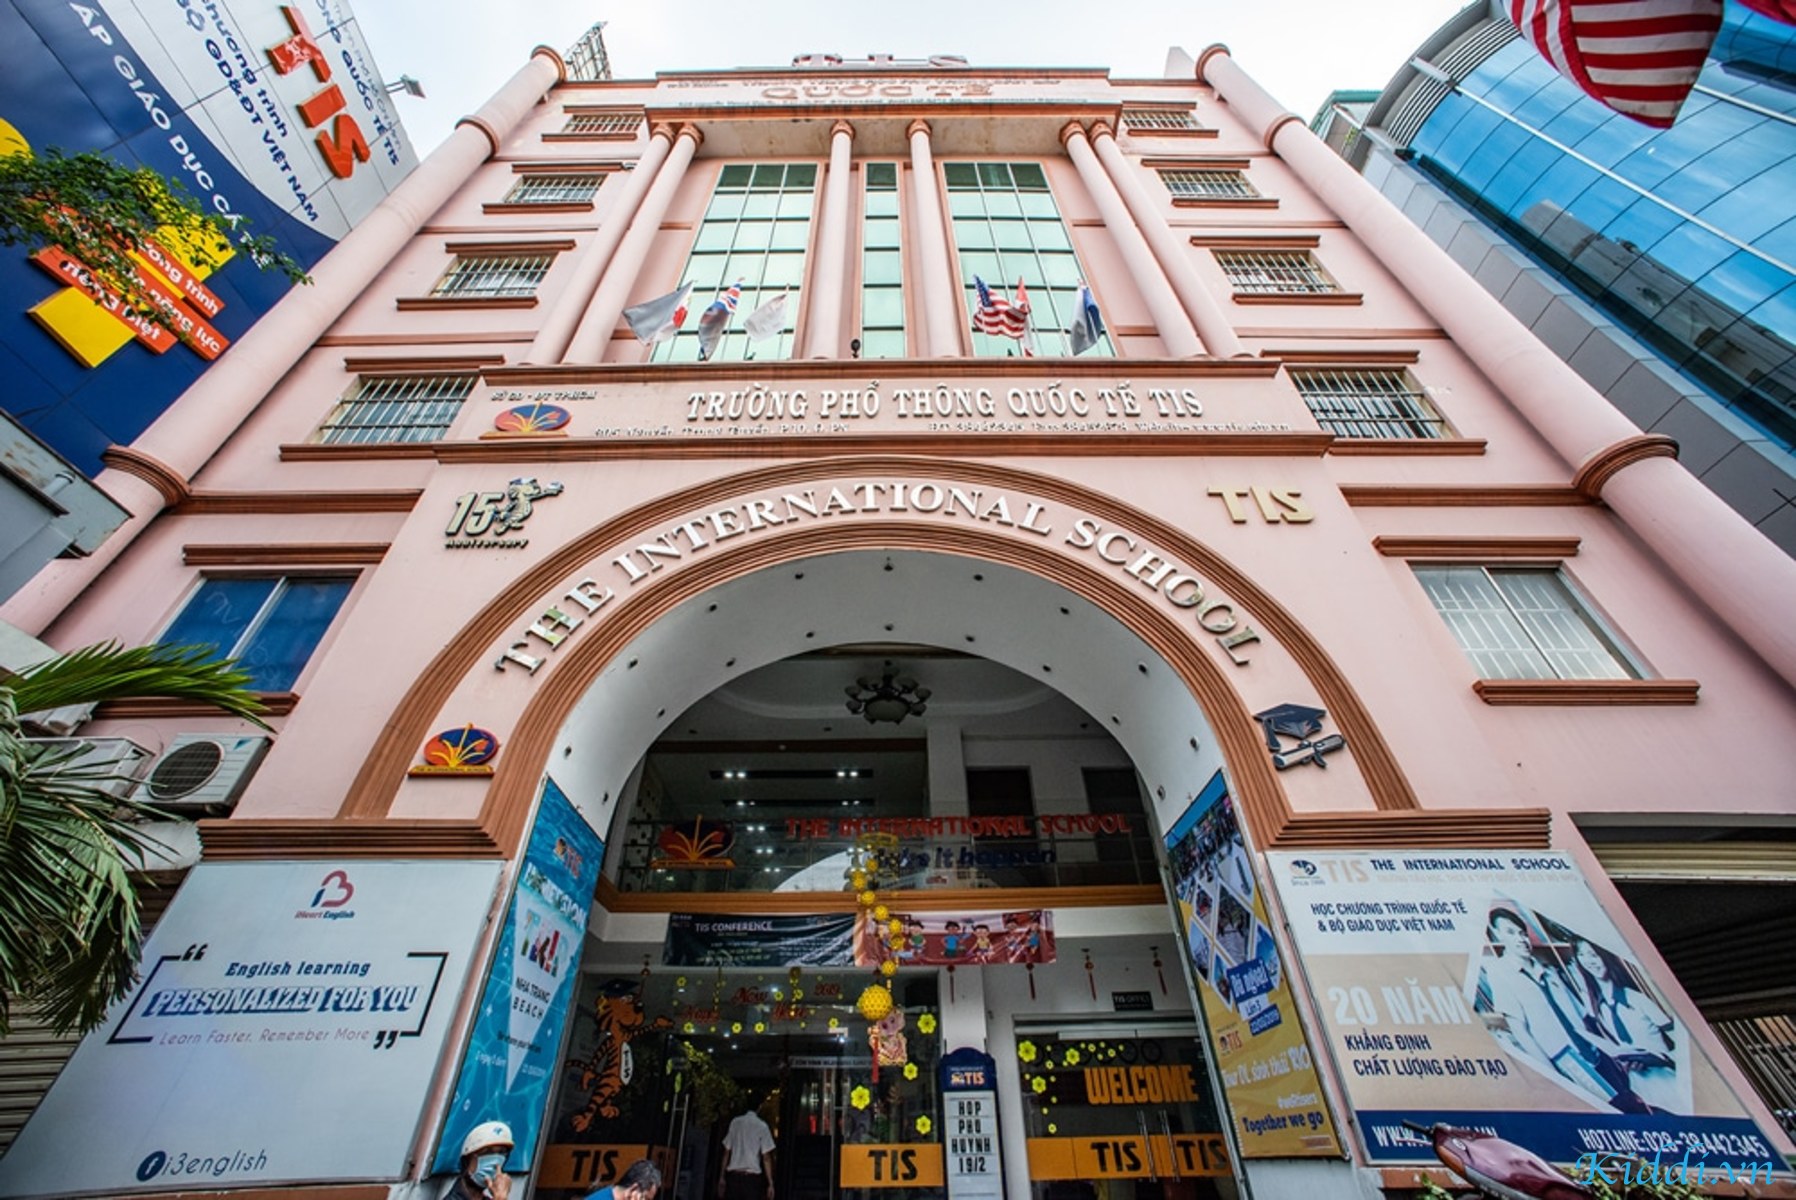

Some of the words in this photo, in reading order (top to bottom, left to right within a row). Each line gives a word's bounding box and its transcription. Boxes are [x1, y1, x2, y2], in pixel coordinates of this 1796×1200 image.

[202, 0, 257, 85] hương
[257, 88, 288, 138] trình
[264, 5, 371, 179] TIS
[113, 55, 171, 130] GIÁO
[169, 134, 214, 191] DỤC
[383, 136, 400, 167] TIS
[262, 129, 292, 173] VIỆT
[287, 175, 319, 222] NAM
[185, 279, 219, 315] trình
[687, 383, 809, 421] TRƯỜNG
[819, 380, 882, 419] PHỔ
[892, 383, 996, 418] THÔNG
[1006, 381, 1090, 417] QUỐC
[1097, 381, 1142, 417] TẾ
[1147, 387, 1204, 417] TIS
[445, 491, 505, 536] 15
[1206, 485, 1315, 524] TIS
[494, 576, 615, 677] THE
[612, 483, 1053, 584] INTERNATIONAL
[1064, 517, 1262, 667] SCHOOL
[785, 817, 830, 838] THE
[1040, 814, 1132, 834] SCHOOL
[1320, 860, 1370, 883] TIS
[1370, 859, 1396, 870] THE
[1402, 858, 1505, 870] INTERNATIONAL
[1511, 858, 1571, 870] SCHOOL
[1311, 903, 1335, 917] HỌC
[1336, 902, 1384, 915] CHƯƠNG
[1384, 900, 1419, 914] TRÌNH
[1420, 898, 1452, 914] QUỐC
[1451, 898, 1468, 914] TẾ
[695, 922, 710, 933] TIS
[711, 920, 774, 932] CONFERENCE
[1318, 920, 1327, 932] &
[1329, 919, 1345, 934] BỘ
[1378, 920, 1400, 934] DỤC
[1402, 918, 1427, 933] VIỆT
[1427, 919, 1456, 931] NAM
[224, 960, 292, 977] English
[296, 960, 372, 977] learning
[516, 977, 531, 992] NHA
[142, 987, 319, 1017] PERSONALIZED
[319, 986, 368, 1013] FOR
[367, 987, 421, 1013] YOU
[513, 996, 544, 1020] BEACH
[1328, 985, 1378, 1025] 20
[1381, 976, 1472, 1025] NĂM
[158, 1031, 202, 1045] Learn
[259, 1028, 330, 1042] Remember
[333, 1027, 370, 1041] More
[1395, 1034, 1431, 1054] ĐỊNH
[964, 1072, 985, 1085] TIS
[1352, 1055, 1393, 1076] CHẤT
[1395, 1058, 1445, 1080] LƯỢNG
[1445, 1054, 1474, 1075] ĐÀO
[1476, 1059, 1508, 1080] TẠO
[1083, 1064, 1199, 1105] WELCOME
[1242, 1113, 1287, 1136] Together
[1288, 1113, 1306, 1128] we
[1307, 1111, 1324, 1131] go
[571, 1150, 619, 1182] TIS
[867, 1149, 918, 1182] TIS
[958, 1157, 986, 1173] 19/2
[1090, 1140, 1142, 1172] TIS
[1176, 1135, 1229, 1170] TIS
